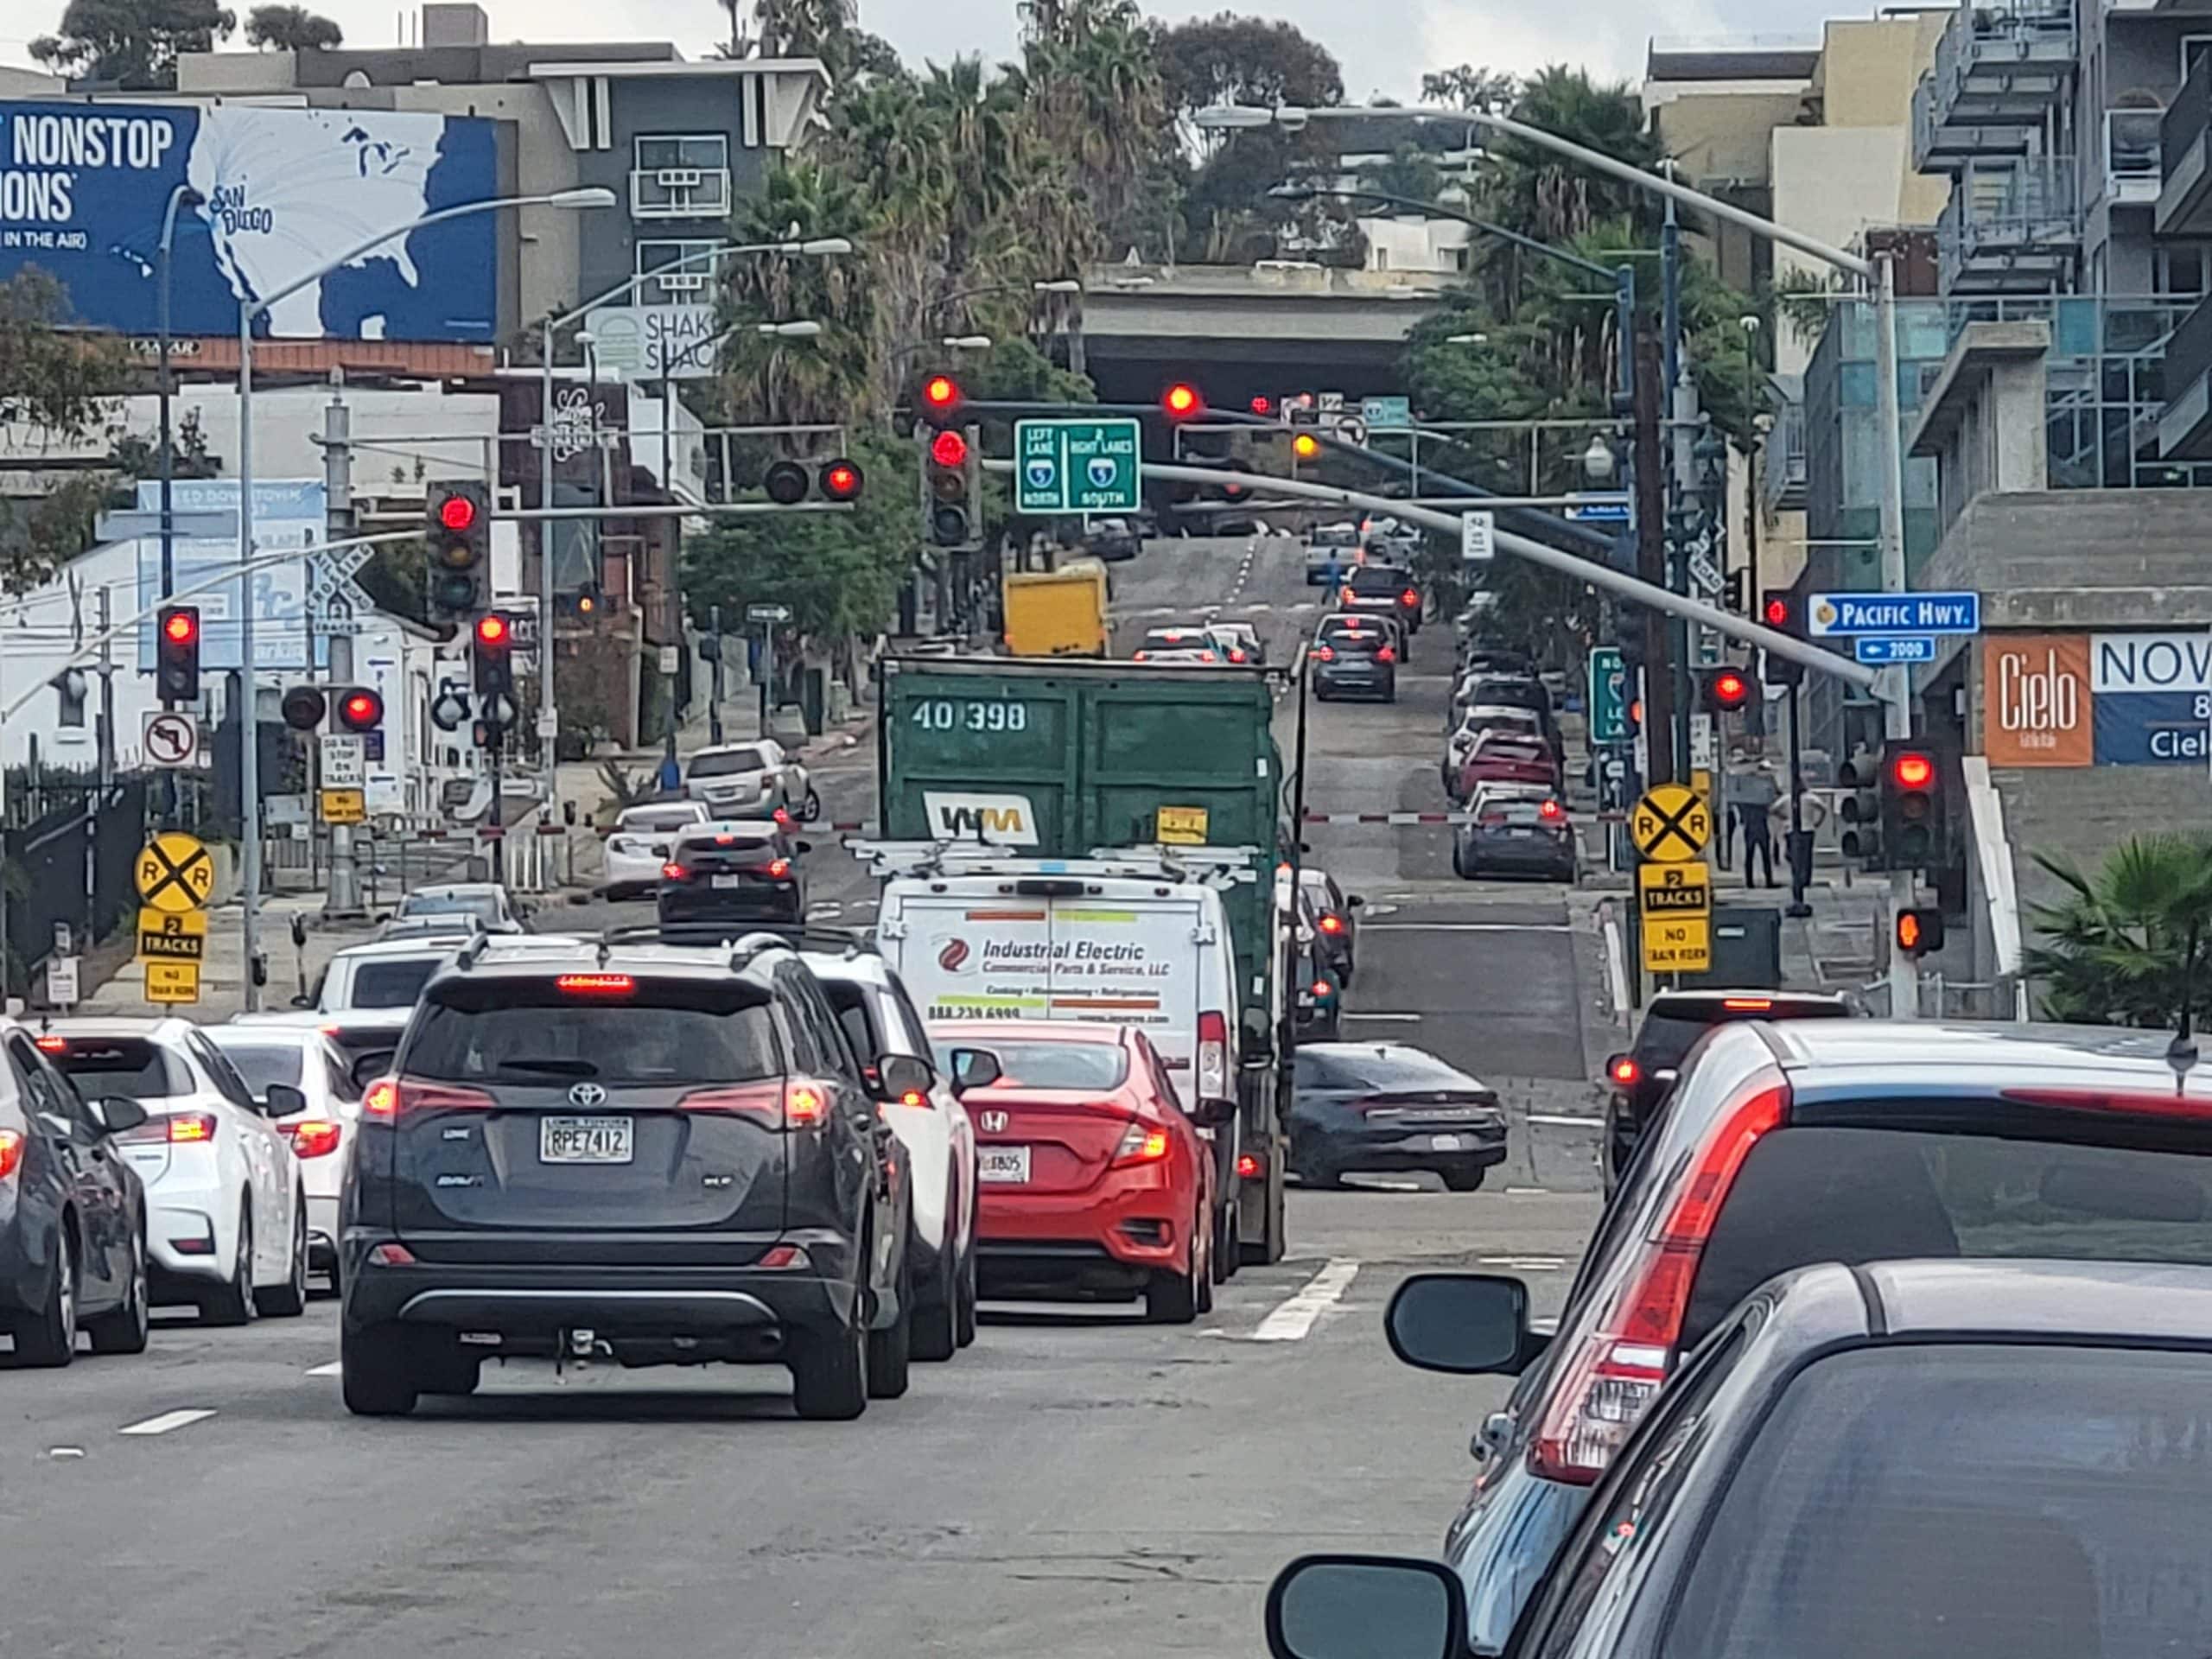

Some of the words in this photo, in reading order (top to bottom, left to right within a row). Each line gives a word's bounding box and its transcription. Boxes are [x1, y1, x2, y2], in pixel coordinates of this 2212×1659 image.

[13, 115, 173, 168] NONSTOP
[0, 170, 73, 222] ONS
[209, 185, 245, 213] SAN
[222, 207, 272, 235] DIEGO
[4, 232, 21, 246] IN
[24, 232, 54, 248] THE
[645, 311, 719, 339] SHAK
[1027, 428, 1053, 442] LEFT
[1095, 429, 1104, 442] 2
[1026, 442, 1054, 455] LANE
[1101, 441, 1134, 454] LANES
[1036, 469, 1047, 484] 5
[1097, 469, 1108, 484] 5
[1081, 492, 1126, 505] SOUTH
[1889, 642, 1924, 658] 2000
[2000, 648, 2076, 731] Cielo
[912, 702, 953, 730] 40
[966, 702, 1027, 731] 398
[940, 807, 1024, 835] WM
[1638, 816, 1654, 836] R
[1690, 814, 1705, 834] R
[142, 861, 158, 880] R
[192, 868, 208, 887] R
[1668, 873, 1681, 888] 2
[1648, 890, 1703, 906] TRACKS
[167, 919, 179, 935] 2
[1664, 928, 1686, 941] NO
[145, 937, 199, 954] TRACKS
[983, 939, 1071, 959] Industrial
[1075, 942, 1145, 960] Electric
[1087, 964, 1095, 975] &
[1148, 965, 1170, 976] LLC
[552, 1130, 622, 1153] RPE7412
